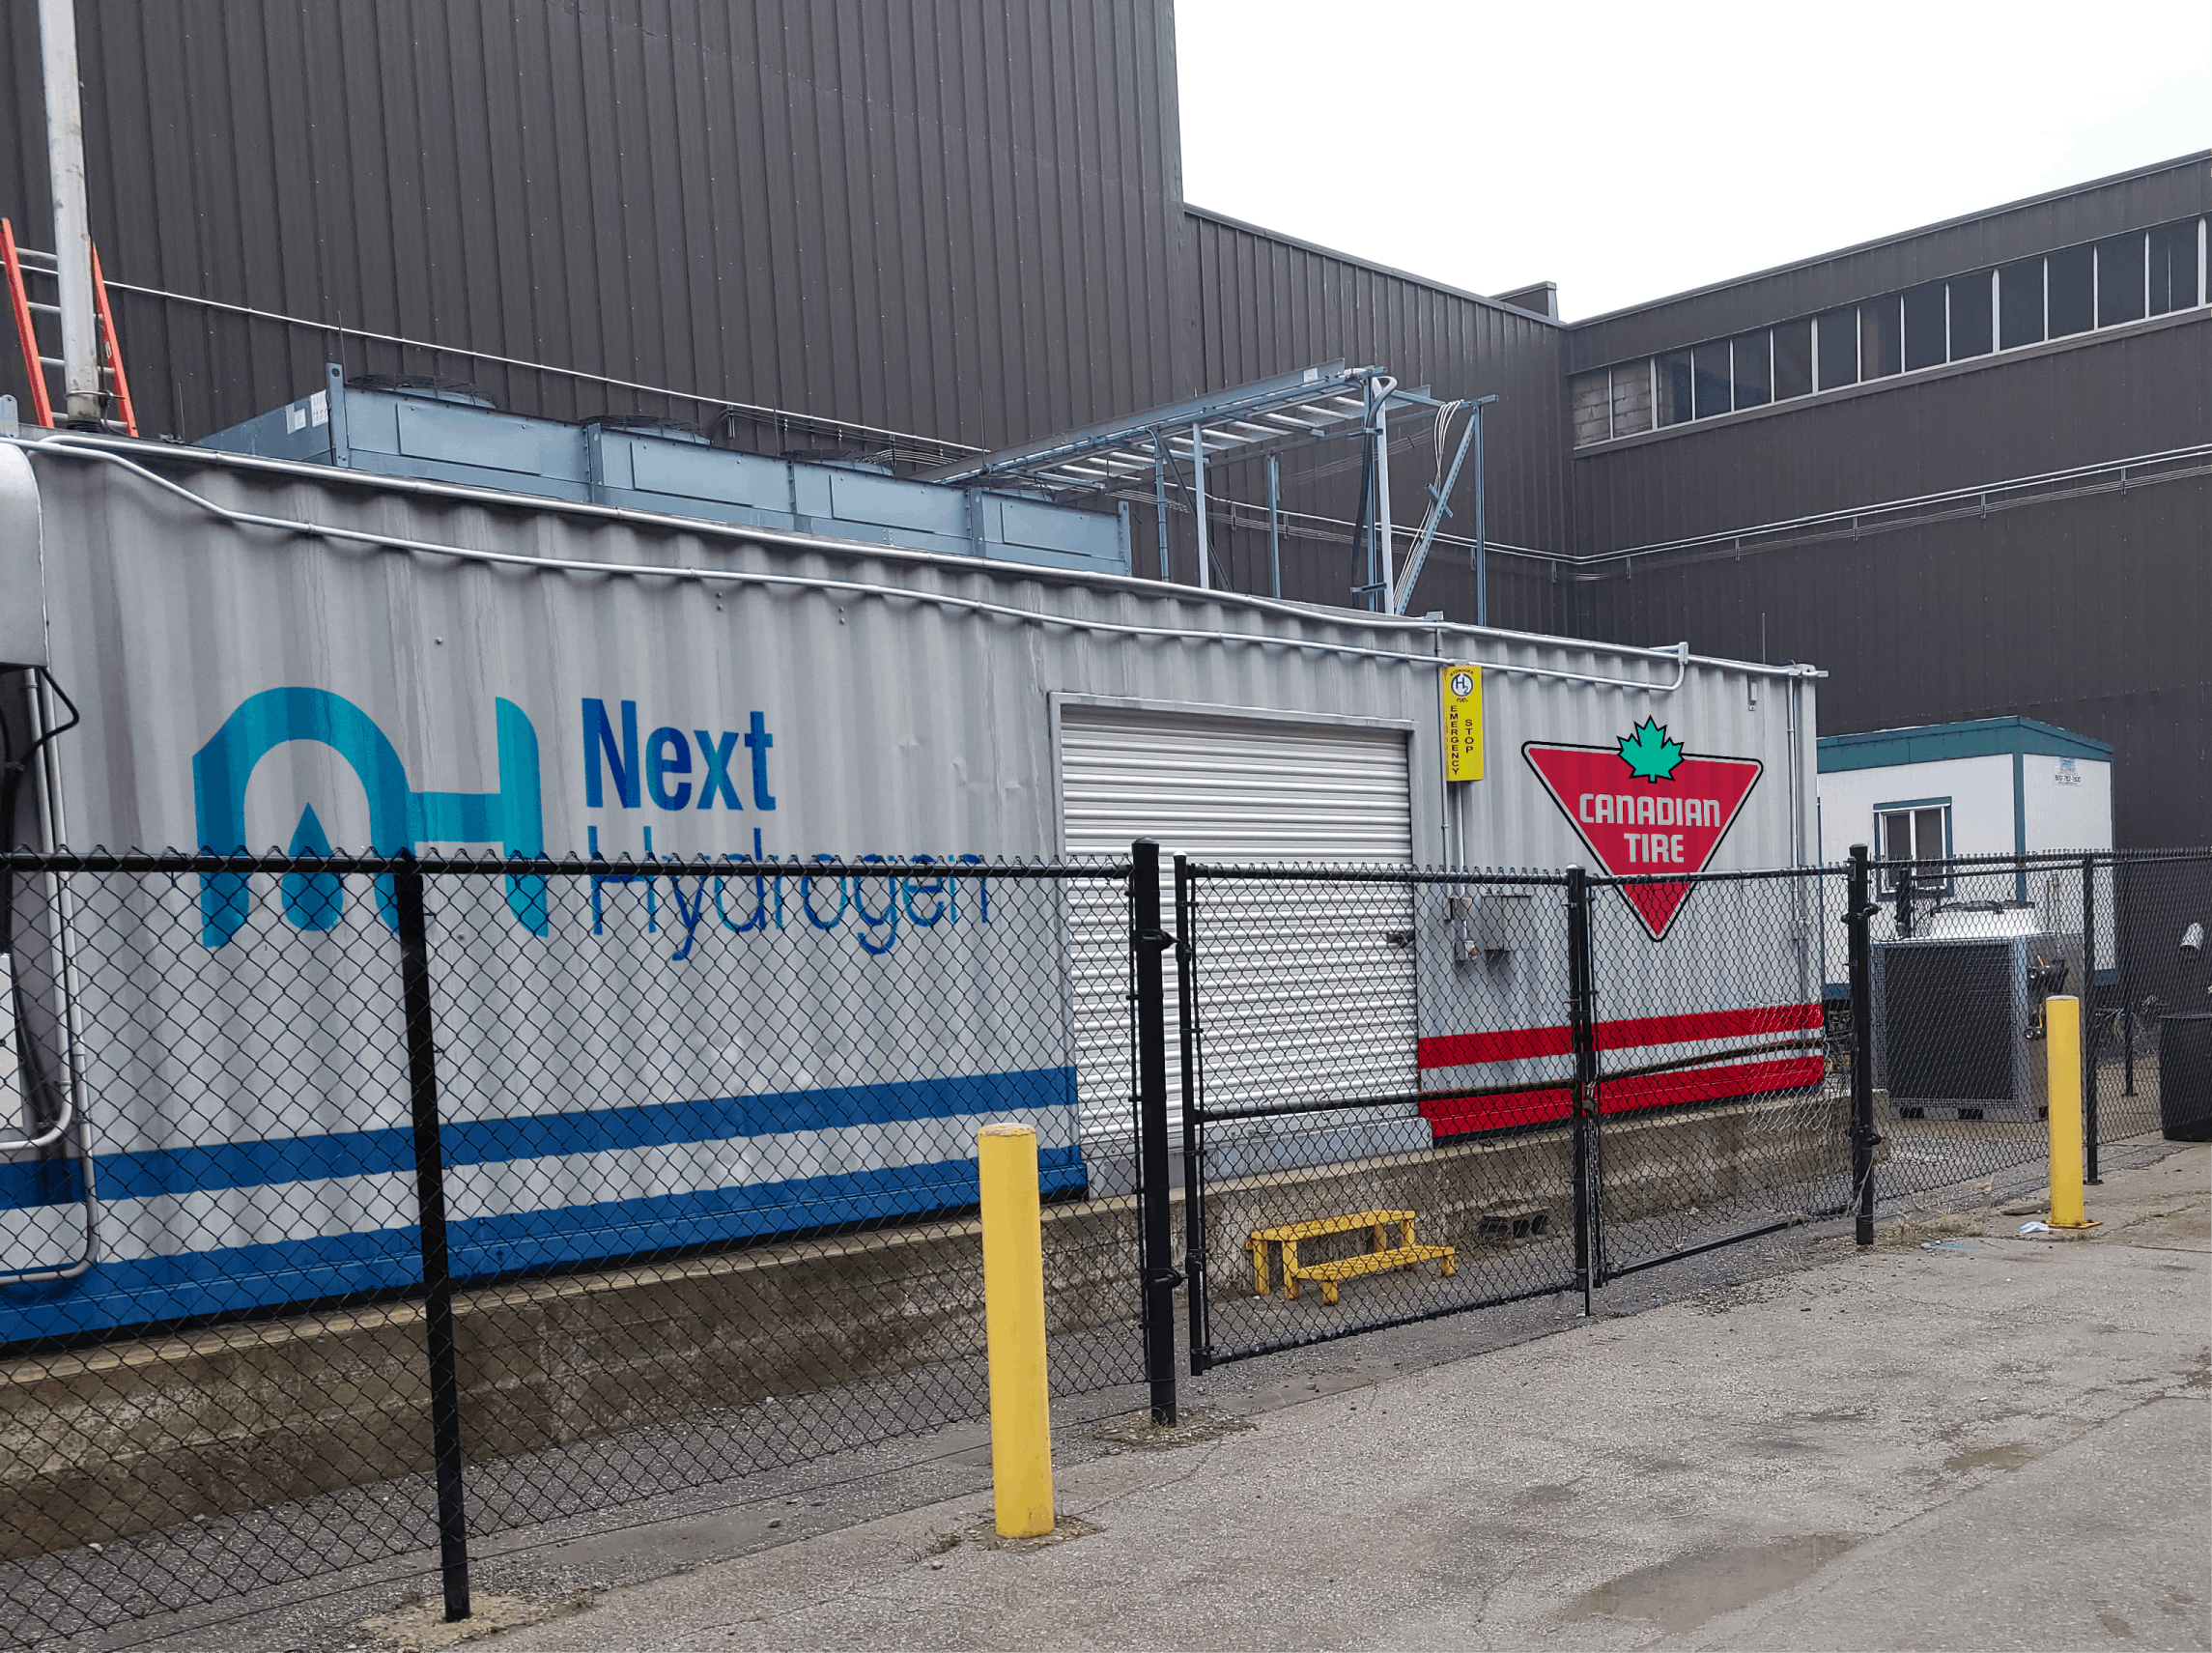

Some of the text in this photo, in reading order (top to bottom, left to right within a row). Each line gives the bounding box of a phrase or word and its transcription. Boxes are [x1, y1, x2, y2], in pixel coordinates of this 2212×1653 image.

[581, 698, 777, 812] Next
[1449, 705, 1460, 775] EMERGENCY
[1464, 719, 1475, 754] STOP
[1579, 792, 1721, 828] CANADIAN
[1623, 832, 1685, 864] TIRE
[587, 825, 989, 961] Hydrogen
